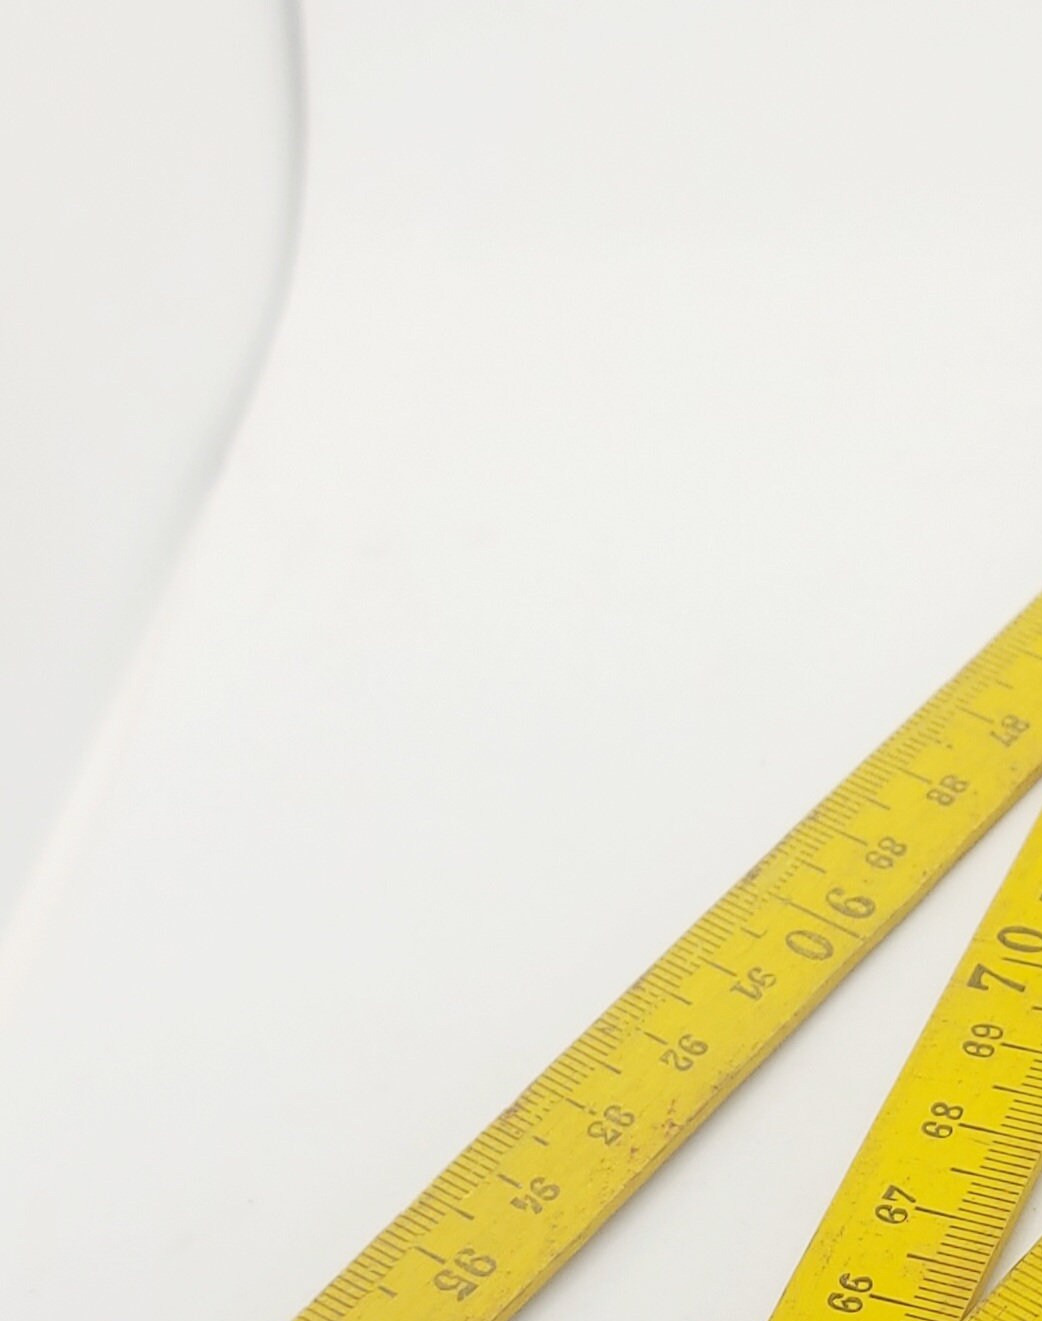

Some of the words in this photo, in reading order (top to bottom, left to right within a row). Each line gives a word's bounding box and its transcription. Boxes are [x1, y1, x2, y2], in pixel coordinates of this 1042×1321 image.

[785, 887, 875, 961] 90
[660, 1034, 709, 1071] 92
[587, 1105, 635, 1146] 93
[827, 1273, 873, 1313] 66
[875, 1185, 916, 1224] 67
[922, 1102, 963, 1139] 68
[963, 1024, 1003, 1058] 69
[510, 1177, 560, 1214] 94
[434, 1248, 496, 1302] 95
